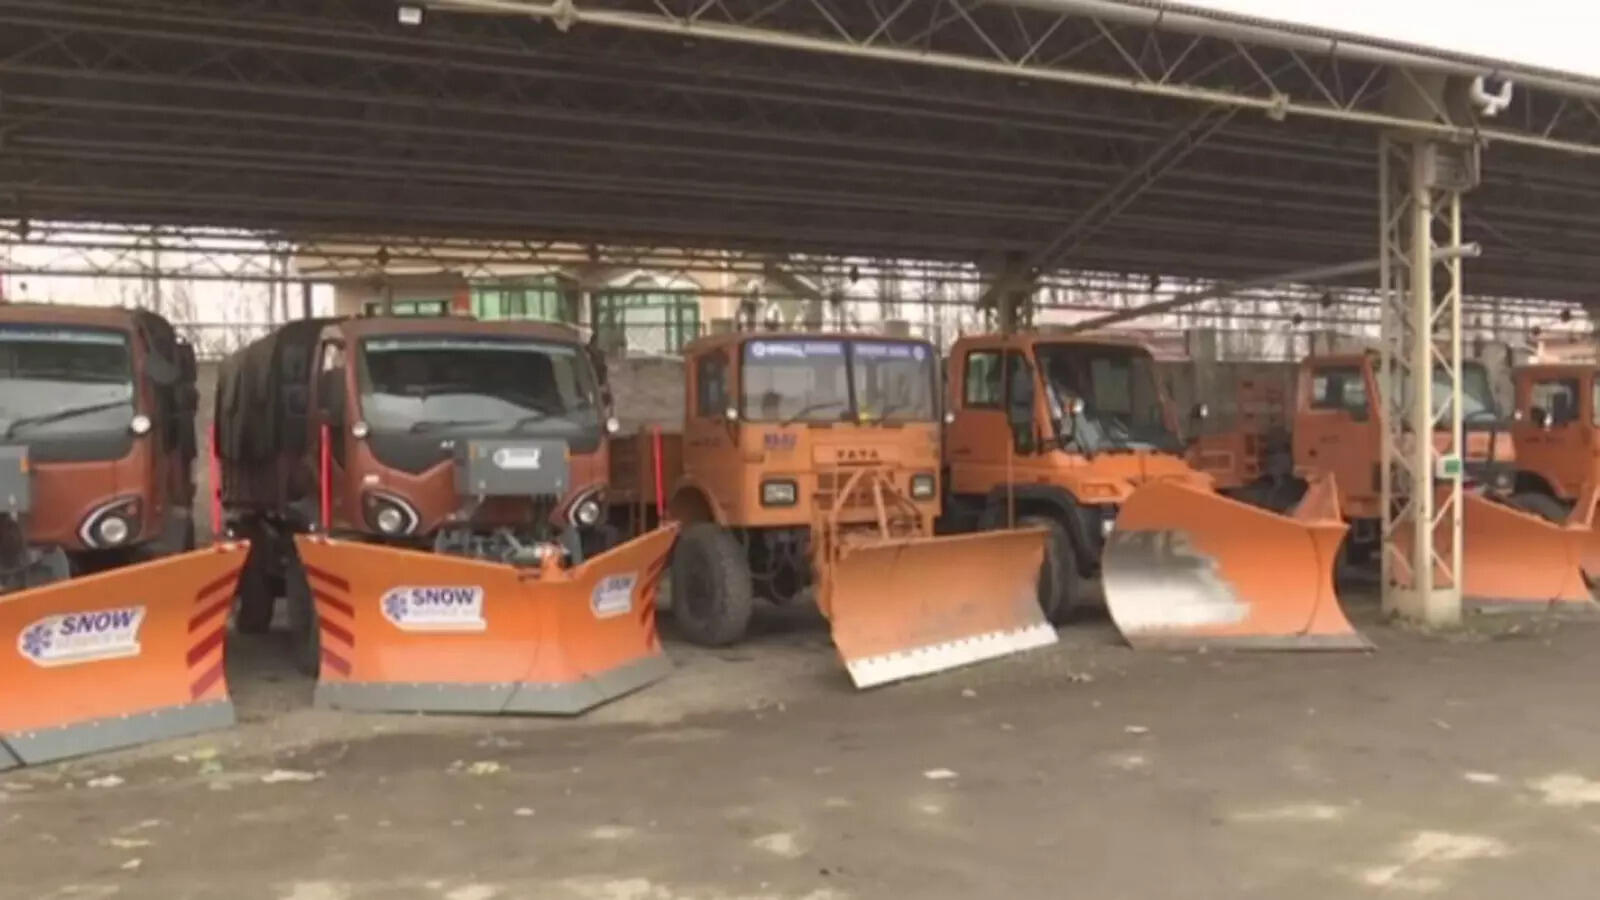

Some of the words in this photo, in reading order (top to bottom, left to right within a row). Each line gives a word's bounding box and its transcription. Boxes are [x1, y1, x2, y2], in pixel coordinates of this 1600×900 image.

[837, 449, 879, 459] TATA
[412, 588, 474, 606] SNOW
[60, 611, 135, 635] SNOW
